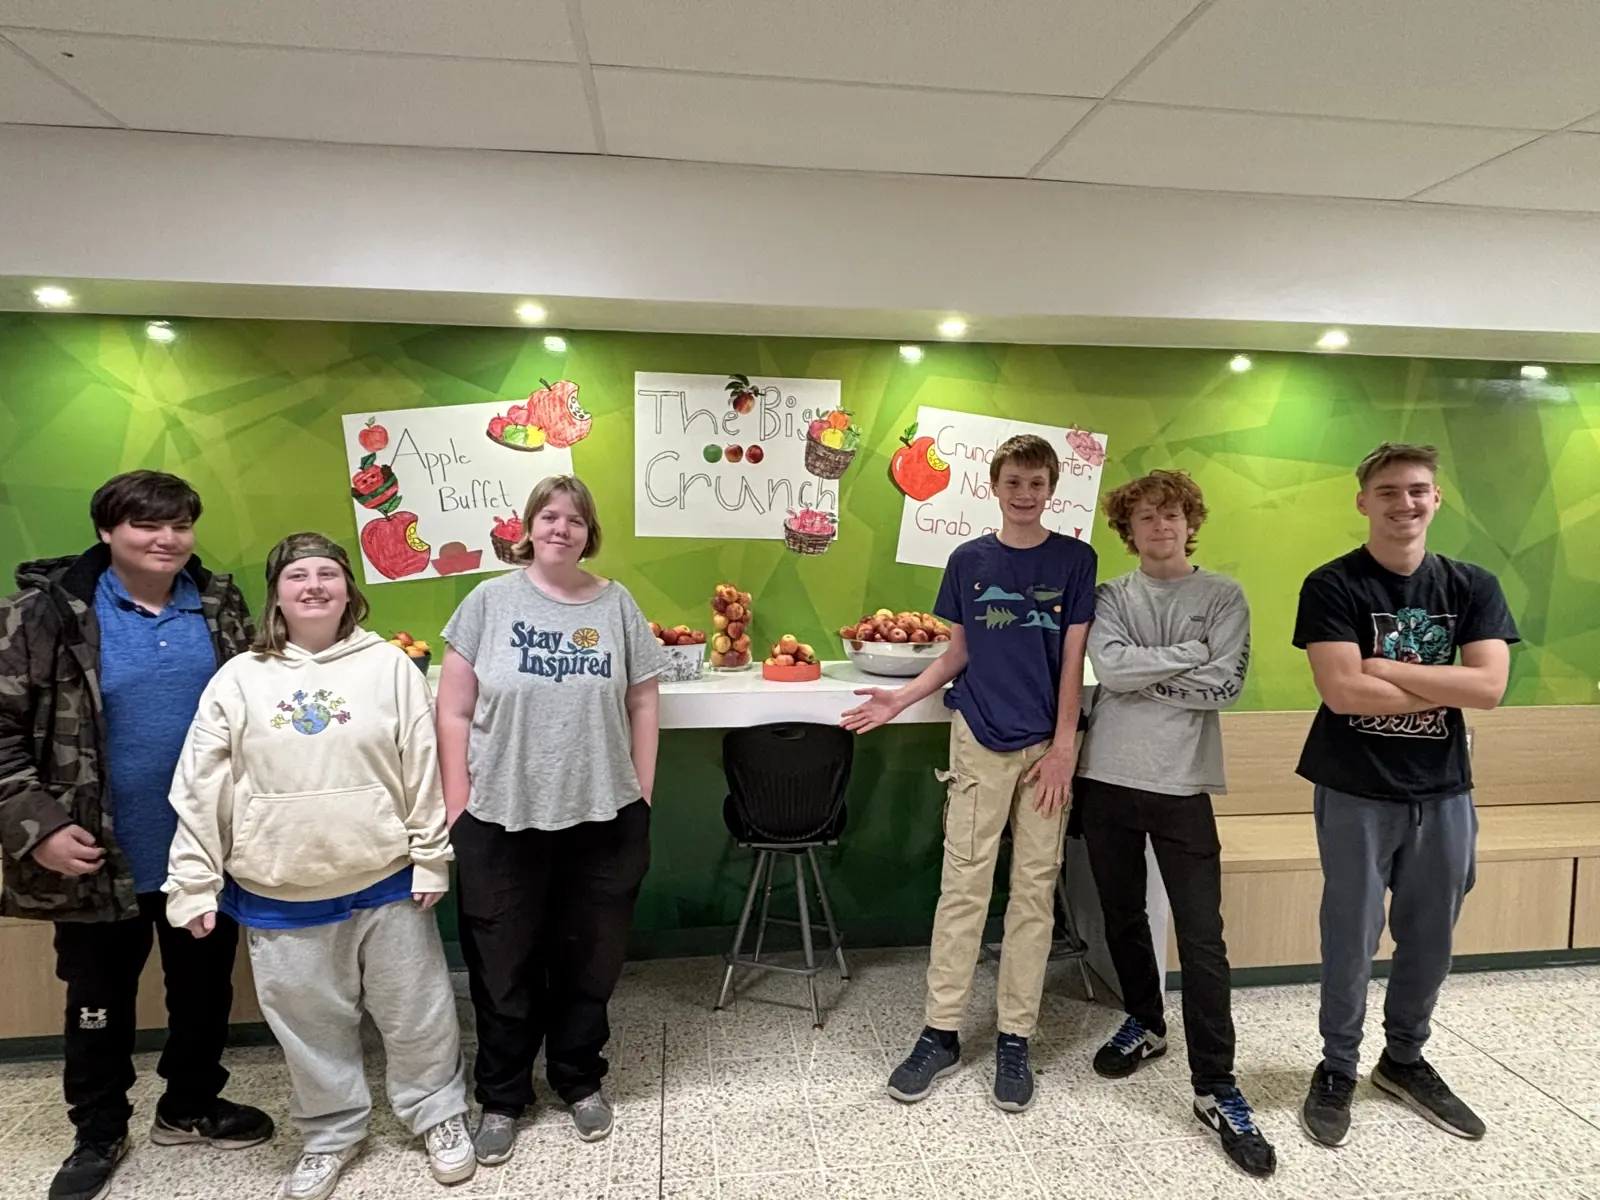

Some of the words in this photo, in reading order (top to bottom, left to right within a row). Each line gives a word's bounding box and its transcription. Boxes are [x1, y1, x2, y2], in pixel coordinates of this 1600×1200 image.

[638, 389, 740, 436] The
[759, 386, 812, 441] Big
[390, 428, 471, 485] Apple
[438, 479, 512, 512] Buffet
[645, 450, 836, 515] Crunch
[915, 502, 972, 537] Grab
[510, 620, 564, 654] Stay
[518, 646, 612, 683] Inspired
[1155, 682, 1190, 699] OFF
[1196, 680, 1240, 701] THE
